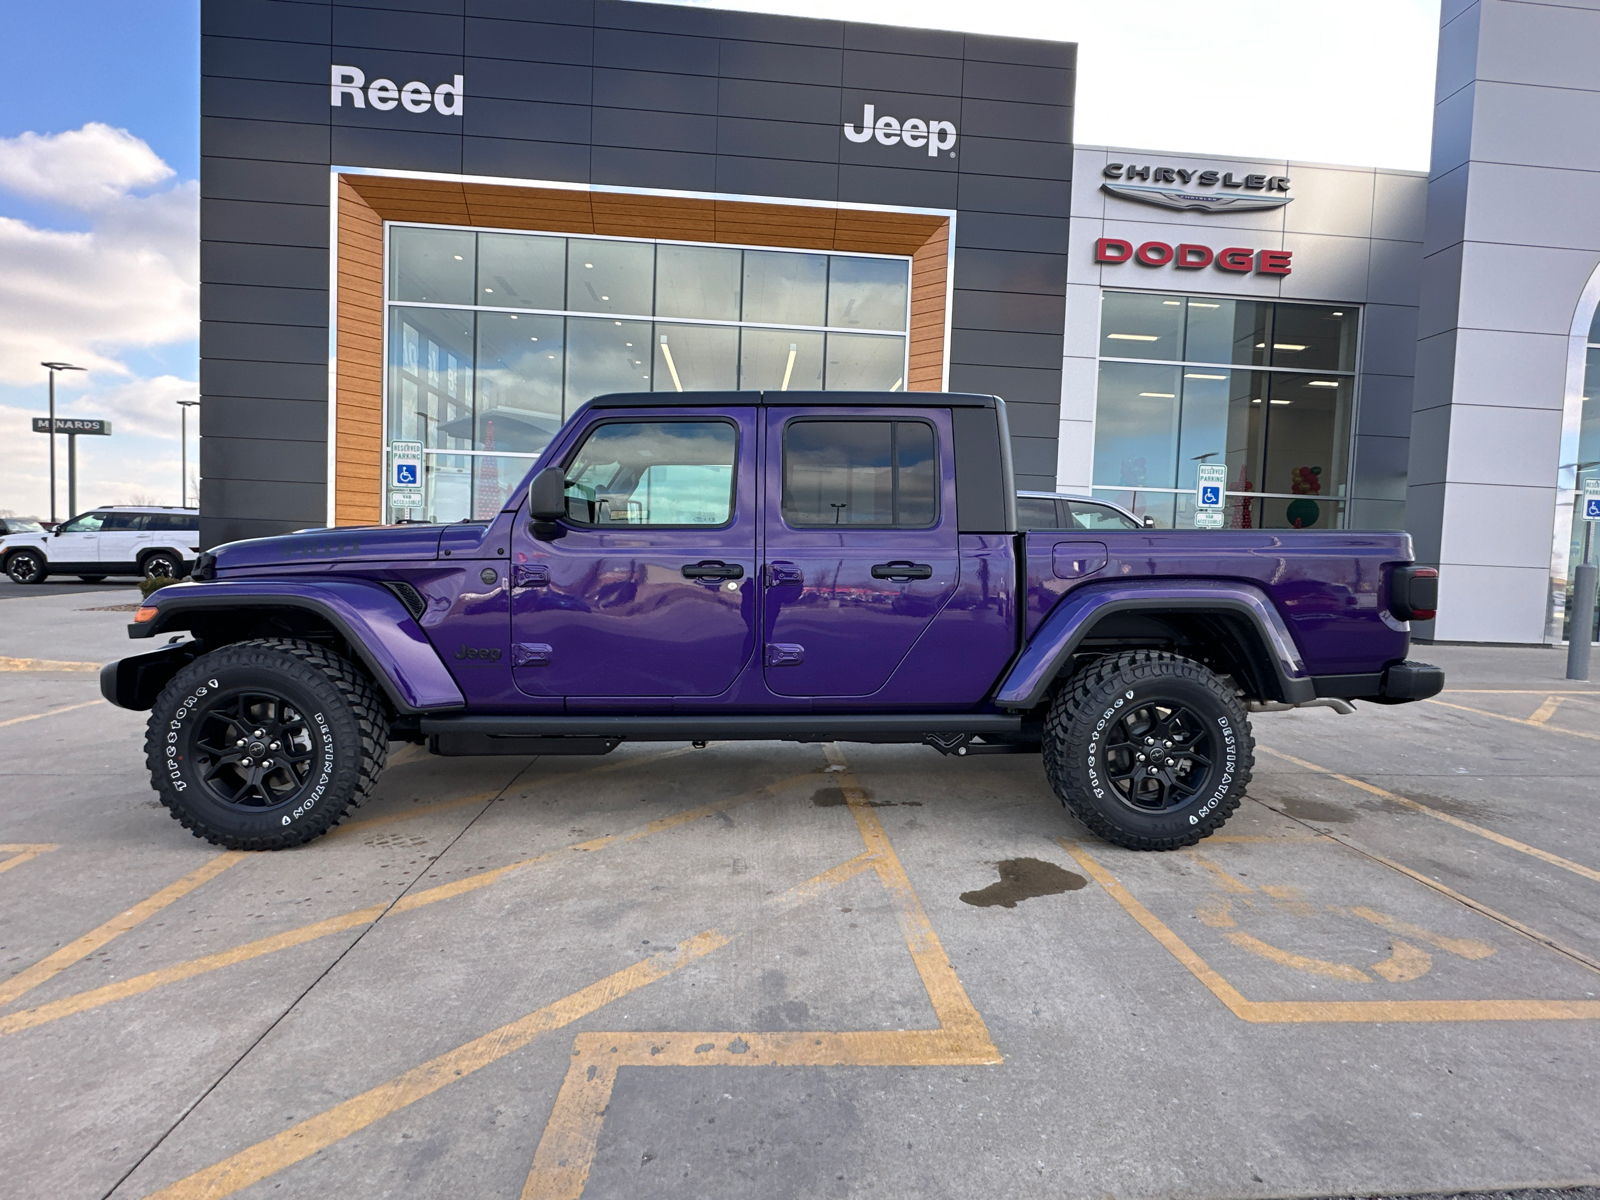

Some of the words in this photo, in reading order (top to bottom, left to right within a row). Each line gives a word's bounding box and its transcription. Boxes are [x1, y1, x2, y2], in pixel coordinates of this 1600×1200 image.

[331, 64, 464, 116] Reed
[843, 103, 957, 158] Jeep
[1103, 162, 1291, 191] CHRYSLER
[1095, 237, 1293, 276] DODGE
[454, 643, 502, 663] Jeep
[293, 712, 334, 820] DESTINATION
[1198, 716, 1237, 819] DESTINATION
